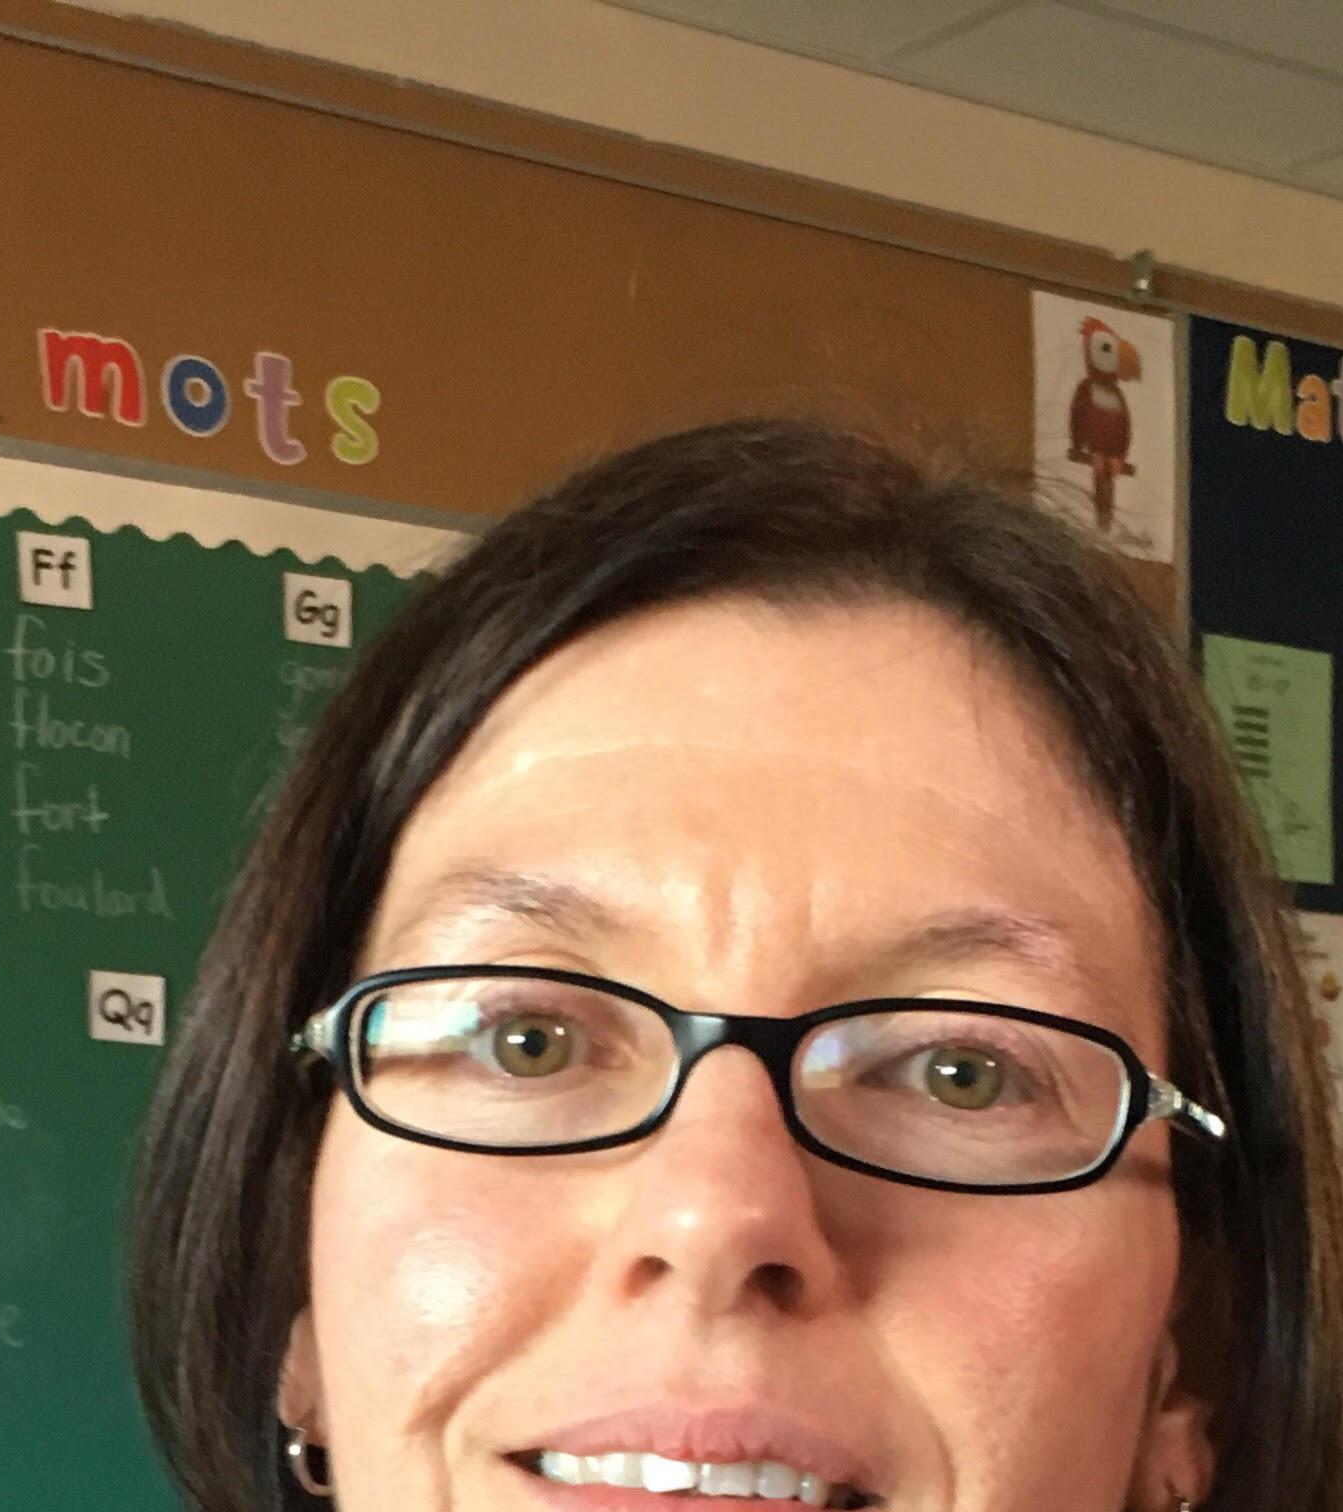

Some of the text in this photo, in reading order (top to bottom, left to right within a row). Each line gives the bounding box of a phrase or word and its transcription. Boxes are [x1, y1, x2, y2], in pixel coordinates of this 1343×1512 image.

[39, 328, 380, 464] mots
[31, 548, 78, 590] Ff
[295, 589, 340, 639] Gg
[99, 988, 153, 1036] Qq
